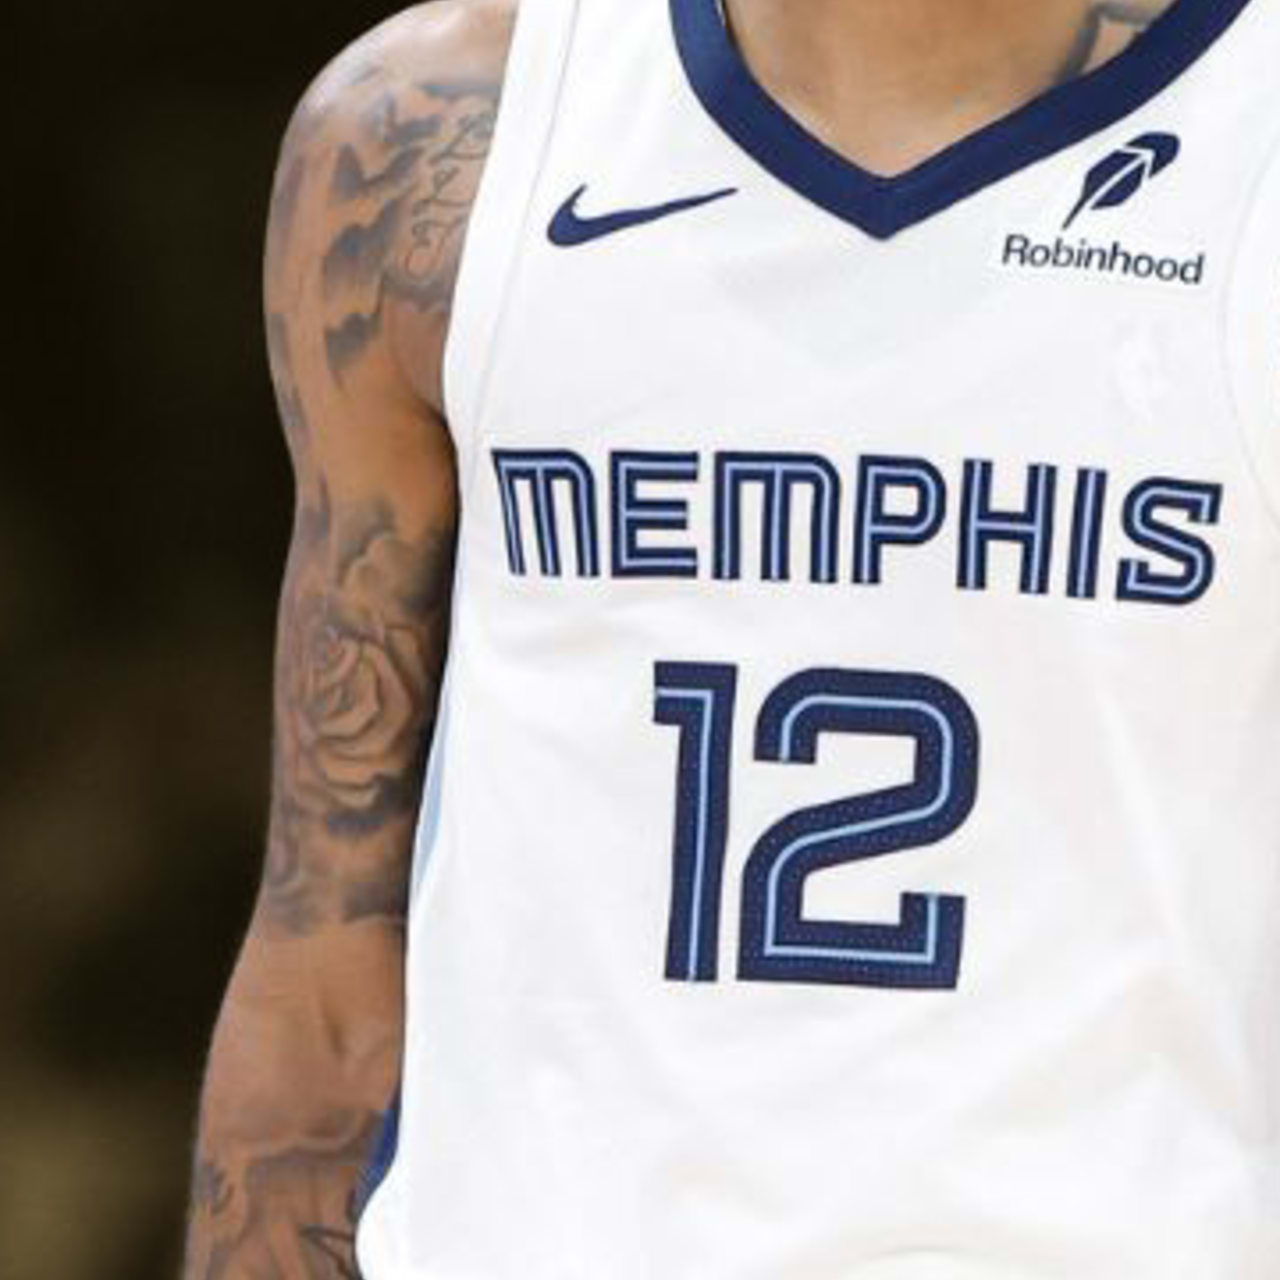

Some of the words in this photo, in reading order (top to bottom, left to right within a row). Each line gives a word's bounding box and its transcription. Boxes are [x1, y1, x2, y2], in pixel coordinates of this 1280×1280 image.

[1001, 233, 1206, 285] Robinhood
[491, 448, 1224, 606] MEMPHIS
[652, 660, 980, 989] 12
